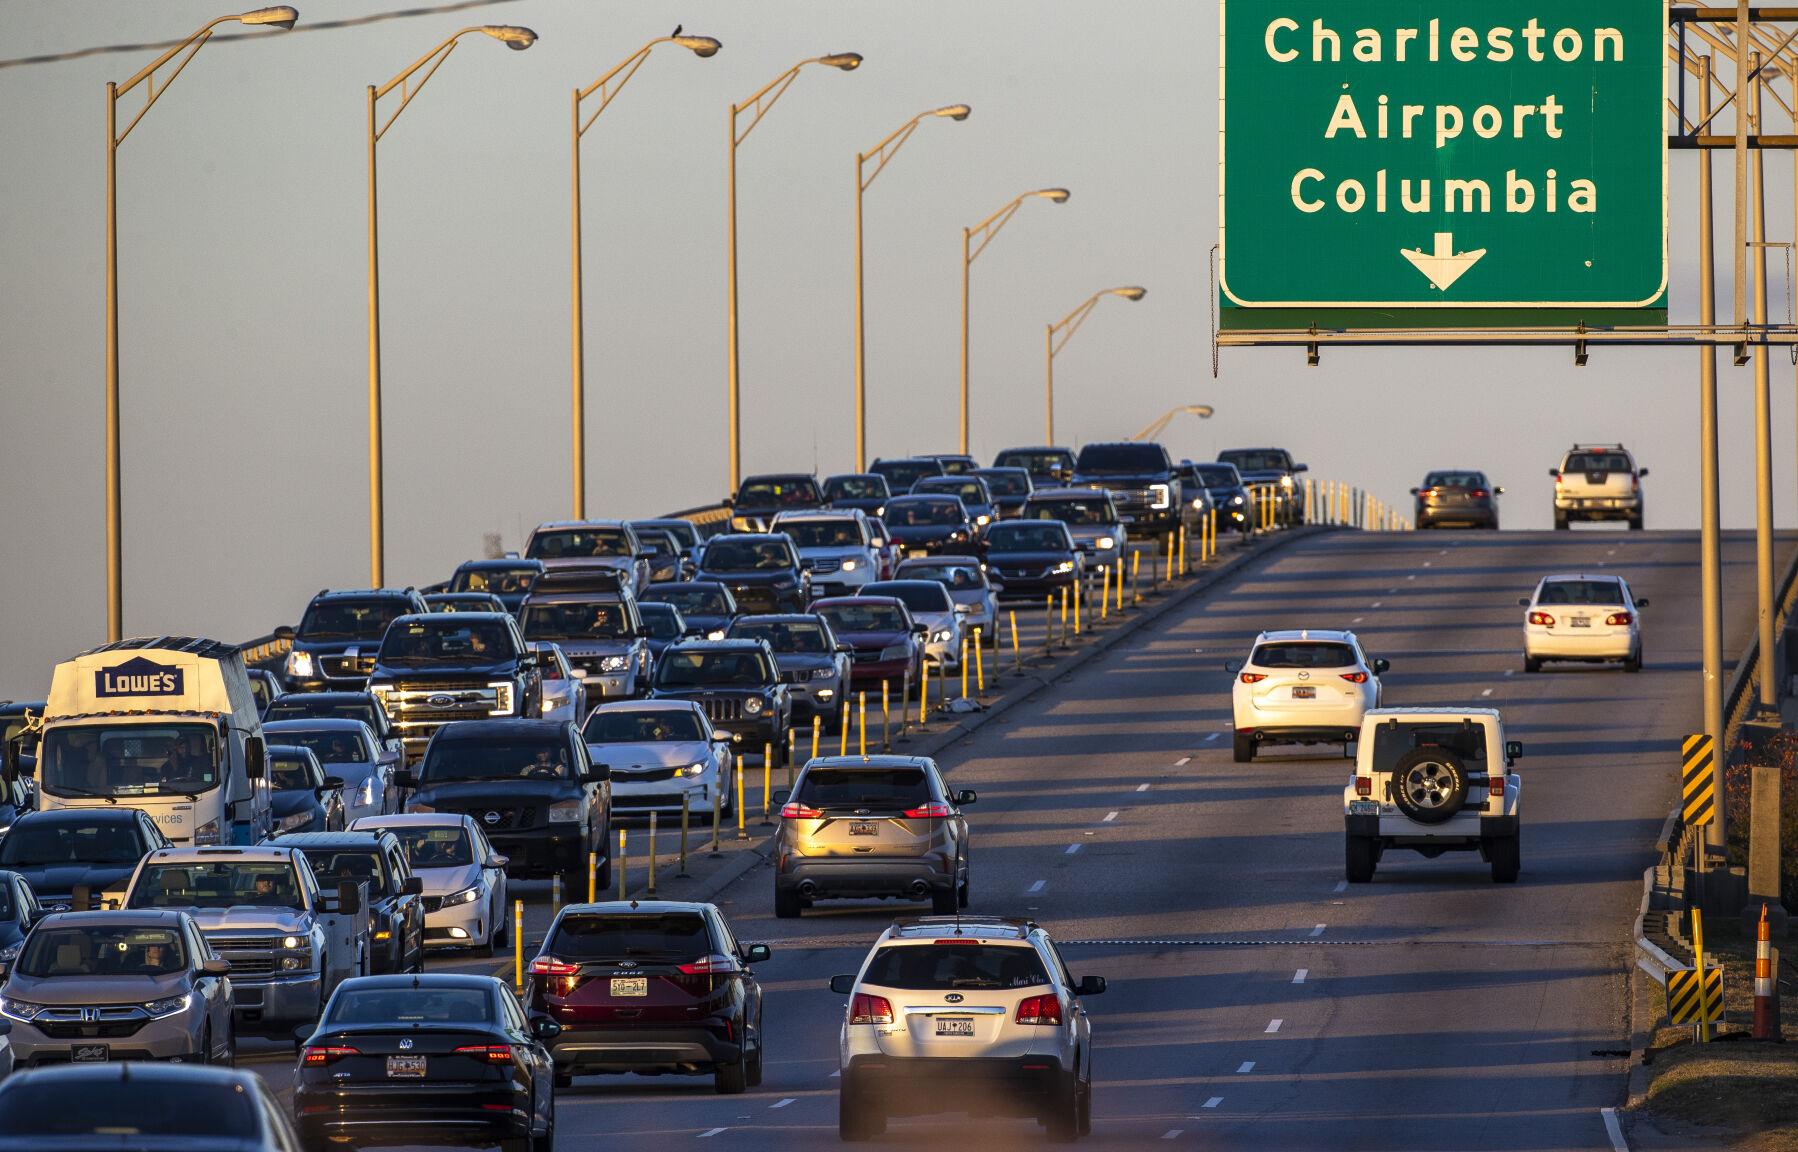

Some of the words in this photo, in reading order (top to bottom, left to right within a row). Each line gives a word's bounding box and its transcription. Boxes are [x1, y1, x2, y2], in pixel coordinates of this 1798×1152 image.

[1264, 18, 1625, 62] Charleston
[1324, 94, 1564, 149] Airport
[1290, 168, 1598, 213] Columbia
[104, 671, 175, 693] LOWE'S
[151, 814, 183, 824] rvices
[937, 1021, 952, 1031] UAJ
[958, 1021, 972, 1031] 206
[411, 1062, 425, 1071] 530
